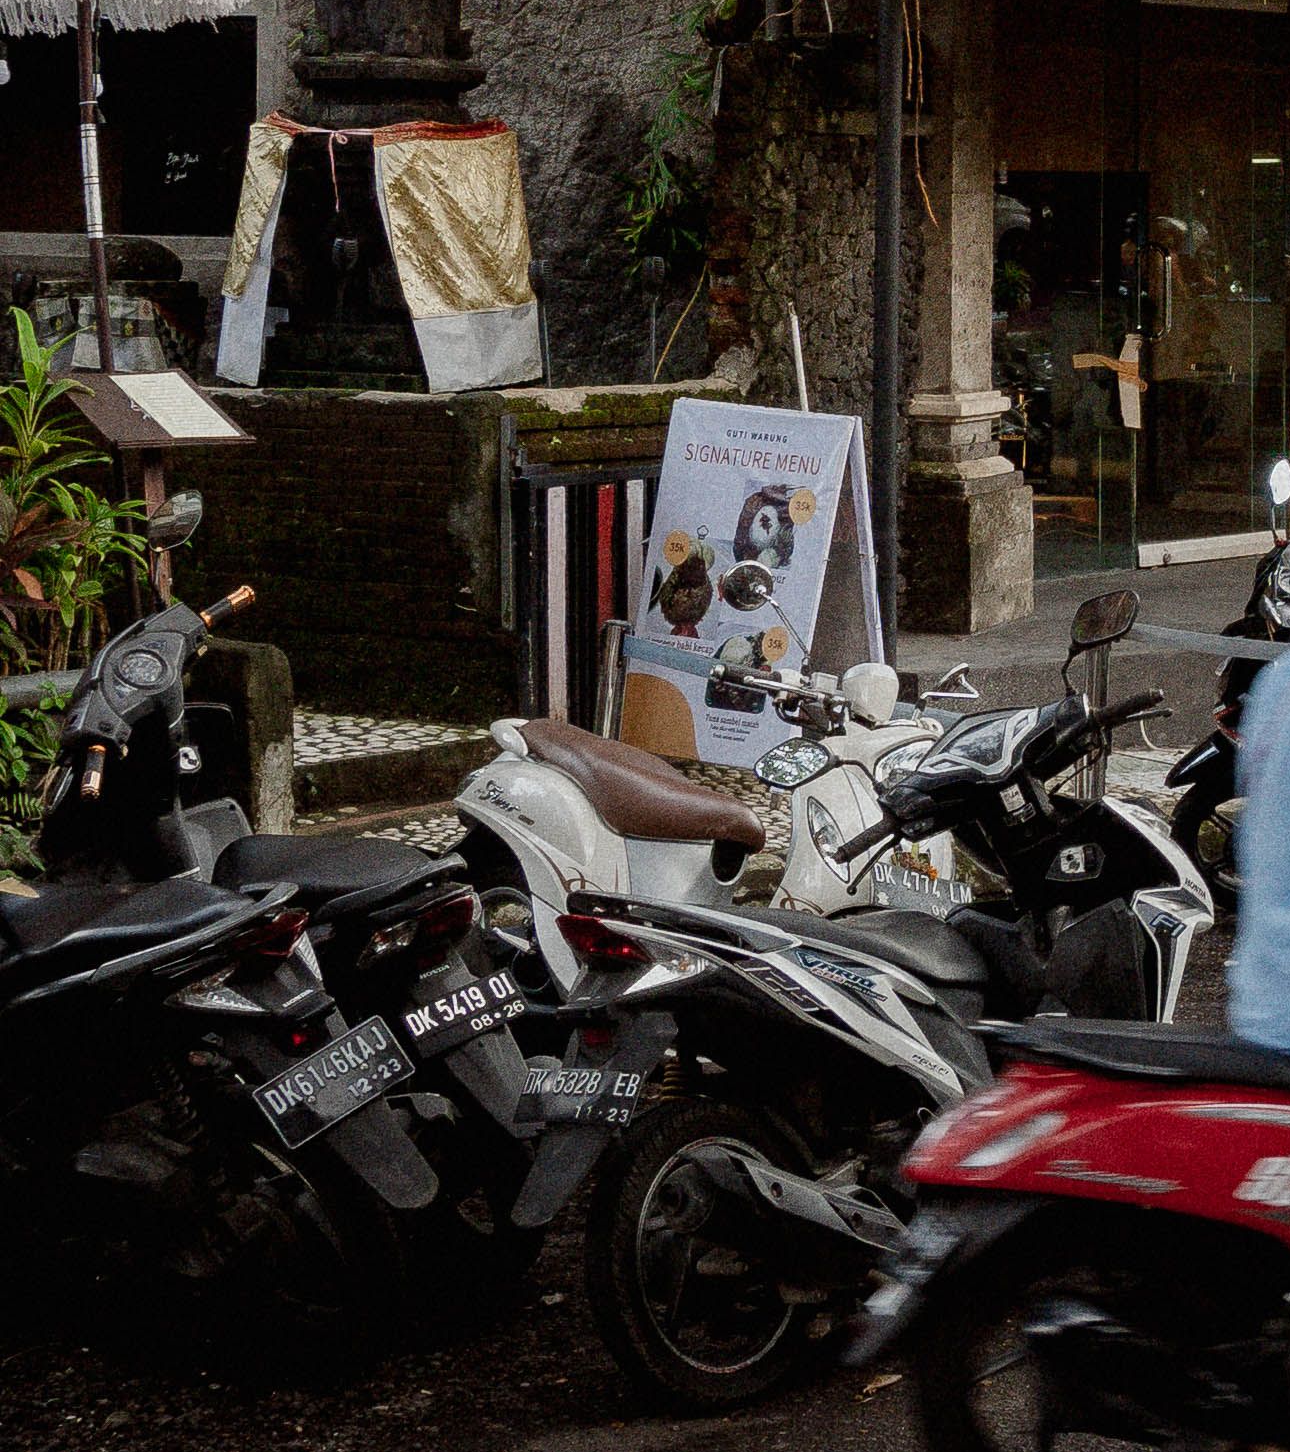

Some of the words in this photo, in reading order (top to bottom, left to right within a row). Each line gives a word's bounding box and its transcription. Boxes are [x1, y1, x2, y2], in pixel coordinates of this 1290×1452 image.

[726, 429, 747, 439] GUTI
[751, 433, 788, 443] WARUNG
[684, 443, 773, 470] SIGNATURE
[775, 454, 821, 475] MENU
[874, 862, 896, 885] DK
[903, 869, 940, 898] 4774
[950, 882, 973, 903] LM
[405, 1005, 439, 1036] DK
[435, 986, 487, 1021] 5419
[522, 1069, 548, 1094] DK
[552, 1071, 602, 1094] 5328
[613, 1072, 641, 1097] EB
